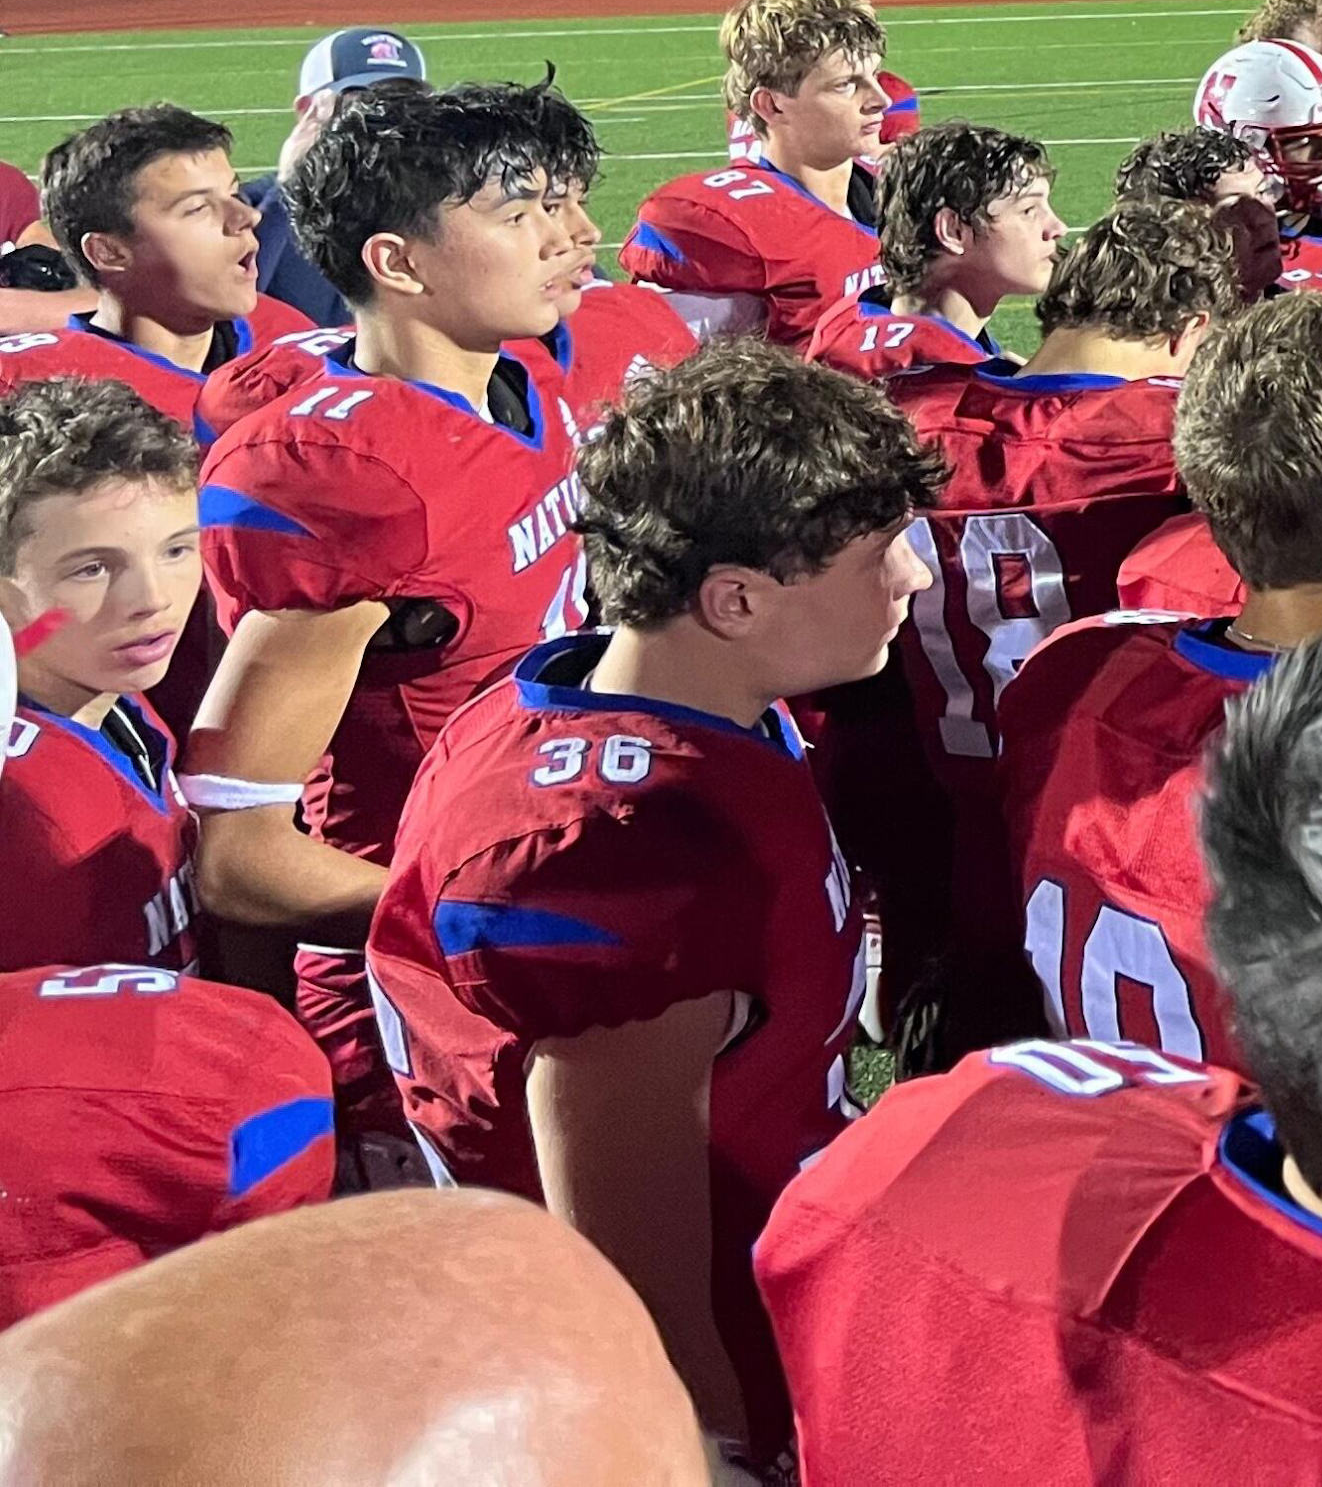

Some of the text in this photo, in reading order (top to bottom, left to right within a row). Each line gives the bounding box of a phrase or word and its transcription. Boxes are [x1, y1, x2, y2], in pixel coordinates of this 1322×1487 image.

[858, 322, 915, 352] 17
[289, 385, 375, 420] 11
[530, 734, 654, 787] 36
